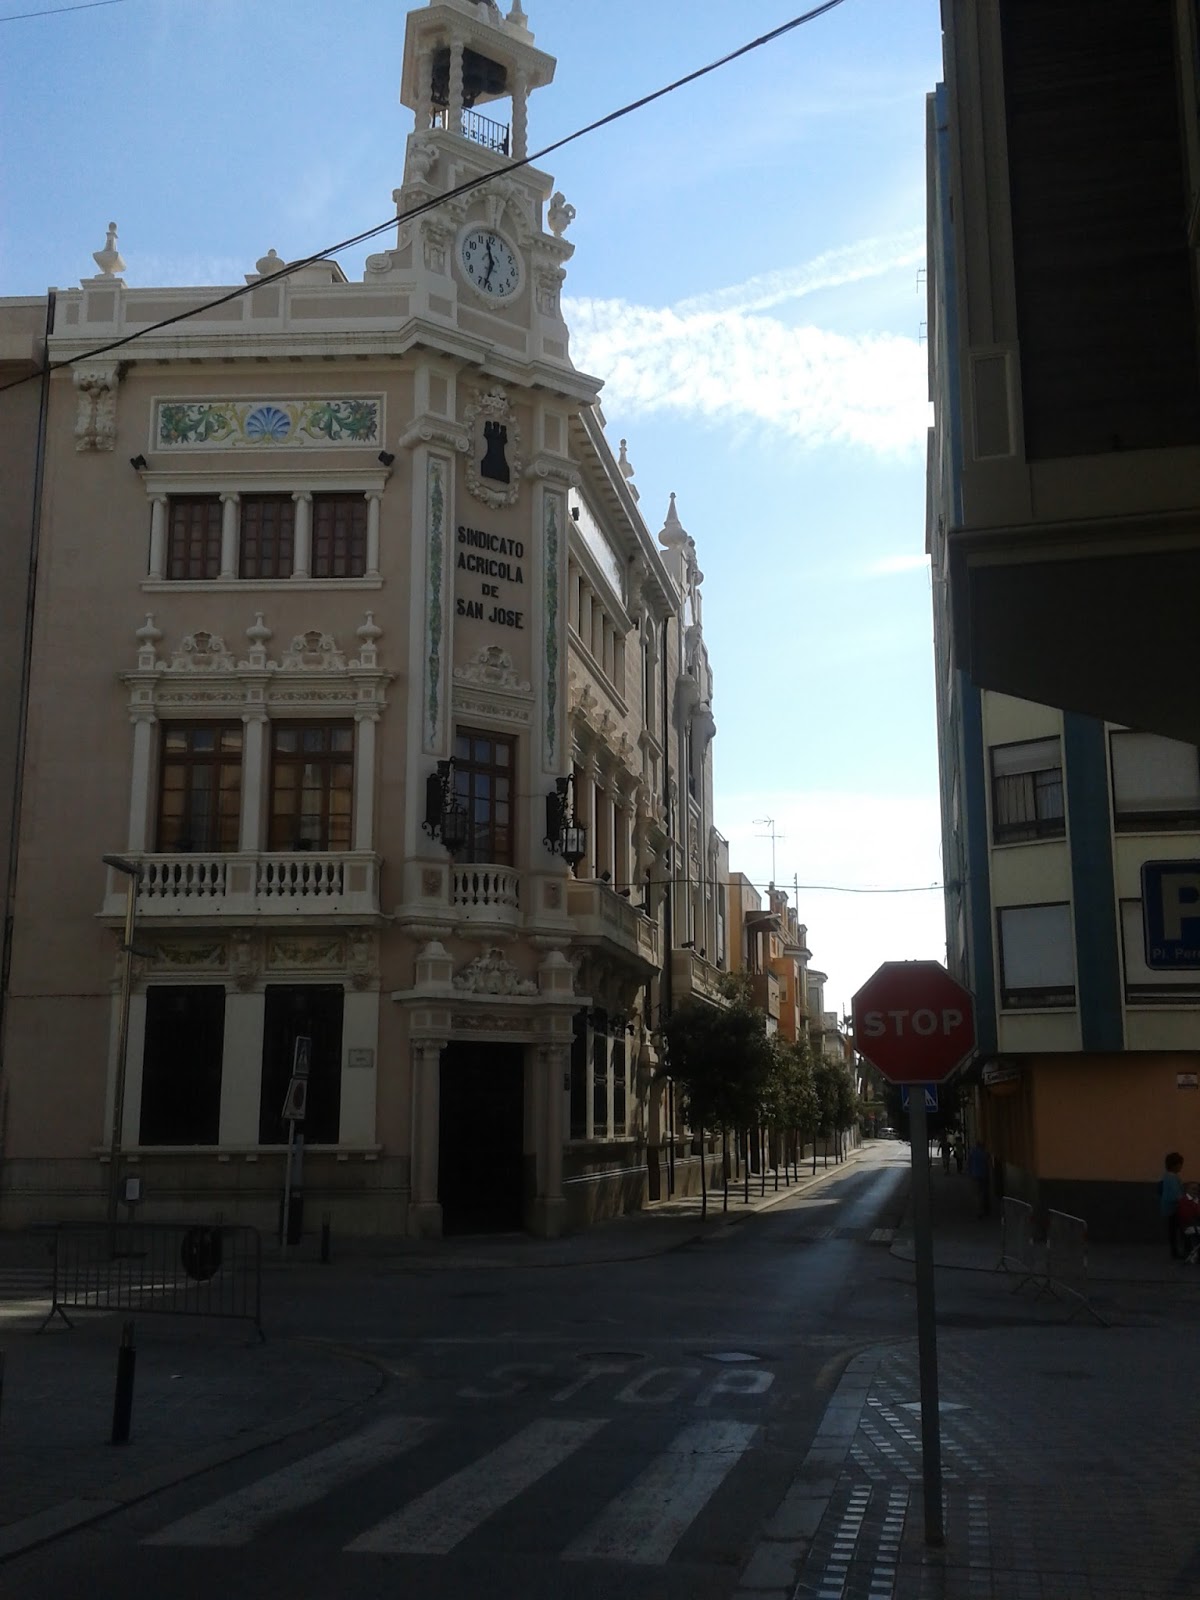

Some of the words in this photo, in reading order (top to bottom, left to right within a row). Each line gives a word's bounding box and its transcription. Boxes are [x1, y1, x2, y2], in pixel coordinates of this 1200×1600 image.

[457, 526, 524, 559] SINDICATO
[457, 552, 524, 584] AGRICOLA
[481, 583, 499, 599] DE
[456, 598, 484, 620] SAN
[488, 606, 524, 630] JOSE
[1160, 872, 1200, 941] P
[863, 1008, 964, 1037] STOP
